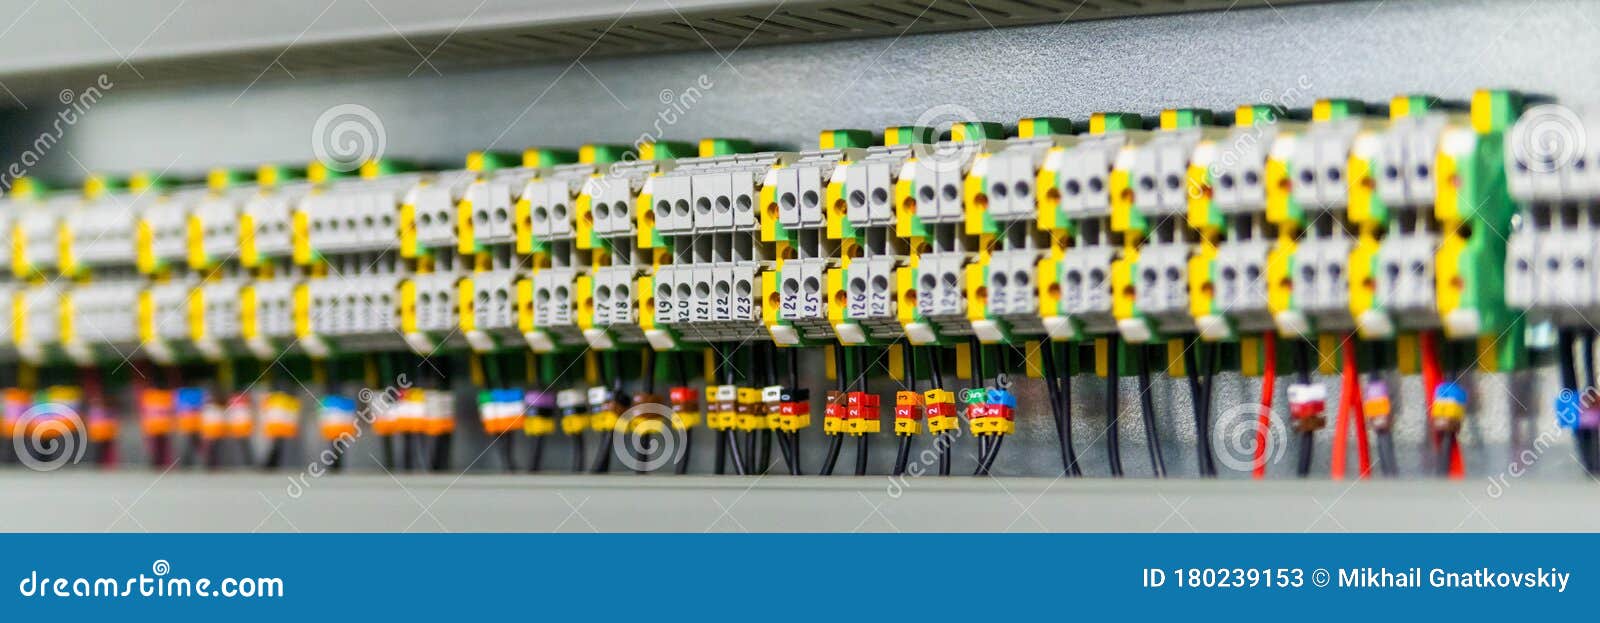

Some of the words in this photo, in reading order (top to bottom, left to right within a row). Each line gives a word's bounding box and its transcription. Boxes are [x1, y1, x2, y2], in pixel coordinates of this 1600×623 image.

[615, 302, 628, 320] 118
[658, 301, 673, 321] 119
[696, 301, 709, 320] 121
[716, 296, 729, 320] 122
[737, 297, 751, 320] 123
[783, 294, 797, 318] 124
[852, 294, 866, 317] 126
[872, 292, 886, 315] 127
